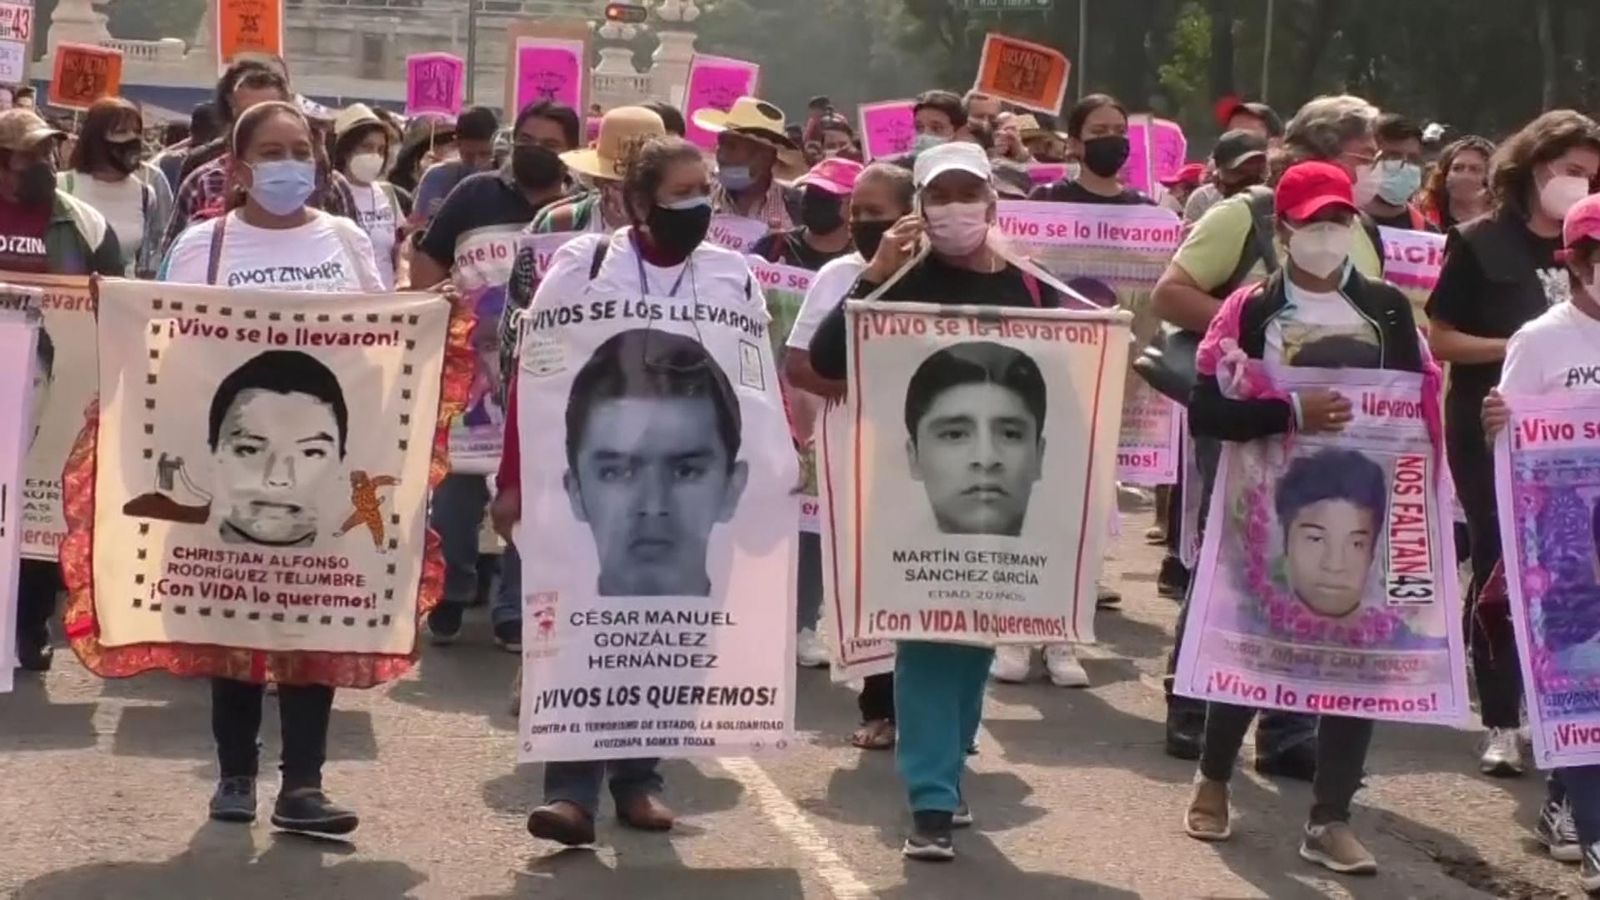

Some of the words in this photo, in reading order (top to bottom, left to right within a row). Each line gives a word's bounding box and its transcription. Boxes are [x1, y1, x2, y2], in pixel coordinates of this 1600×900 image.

[12, 8, 29, 39] 43
[1046, 224, 1067, 237] se
[1075, 221, 1090, 238] lo
[1098, 222, 1180, 243] llevaron!
[228, 261, 344, 287] AYOTZINAPA
[788, 274, 809, 289] se
[590, 301, 617, 320] SE
[623, 300, 662, 320] LOS
[168, 318, 229, 339] ¡Vivo
[236, 327, 261, 343] se
[267, 329, 288, 346] lo
[296, 328, 399, 347] llevaron!
[863, 312, 927, 341] ¡Vivo
[934, 320, 960, 336] se
[1515, 418, 1575, 450] ¡Vivo
[1394, 455, 1424, 495] NOS
[1390, 502, 1428, 574] FALTAN
[173, 546, 263, 564] CHRISTIAN
[269, 555, 349, 569] ALFONSO
[892, 549, 960, 563] MARTÍN
[965, 551, 1048, 568] GETSEMANY
[168, 562, 268, 583] RODRÍGUEZ
[274, 571, 366, 588] TELUMBRE
[905, 566, 989, 582] SÁNCHEZ
[992, 569, 1039, 586] GARCÍA
[150, 578, 194, 599] ¡Con
[200, 582, 247, 600] VIDA
[253, 585, 271, 603] lo
[276, 591, 377, 610] queremos!
[569, 608, 640, 627] CÉSAR
[645, 610, 738, 626] MANUEL
[868, 609, 911, 635] ¡Con
[919, 609, 967, 633] VIDA
[973, 609, 989, 632] lo
[990, 615, 1068, 639] queremos!
[594, 629, 707, 648] GONZÁLEZ
[588, 651, 719, 670] HERNÁNDEZ
[534, 687, 602, 714] ¡VIVOS
[606, 685, 641, 706] LOS
[646, 685, 778, 709] QUEREMOS!
[1206, 671, 1267, 700] ¡Vivo
[1275, 684, 1297, 706] lo
[1306, 692, 1439, 713] queremos!
[700, 720, 713, 730] LA
